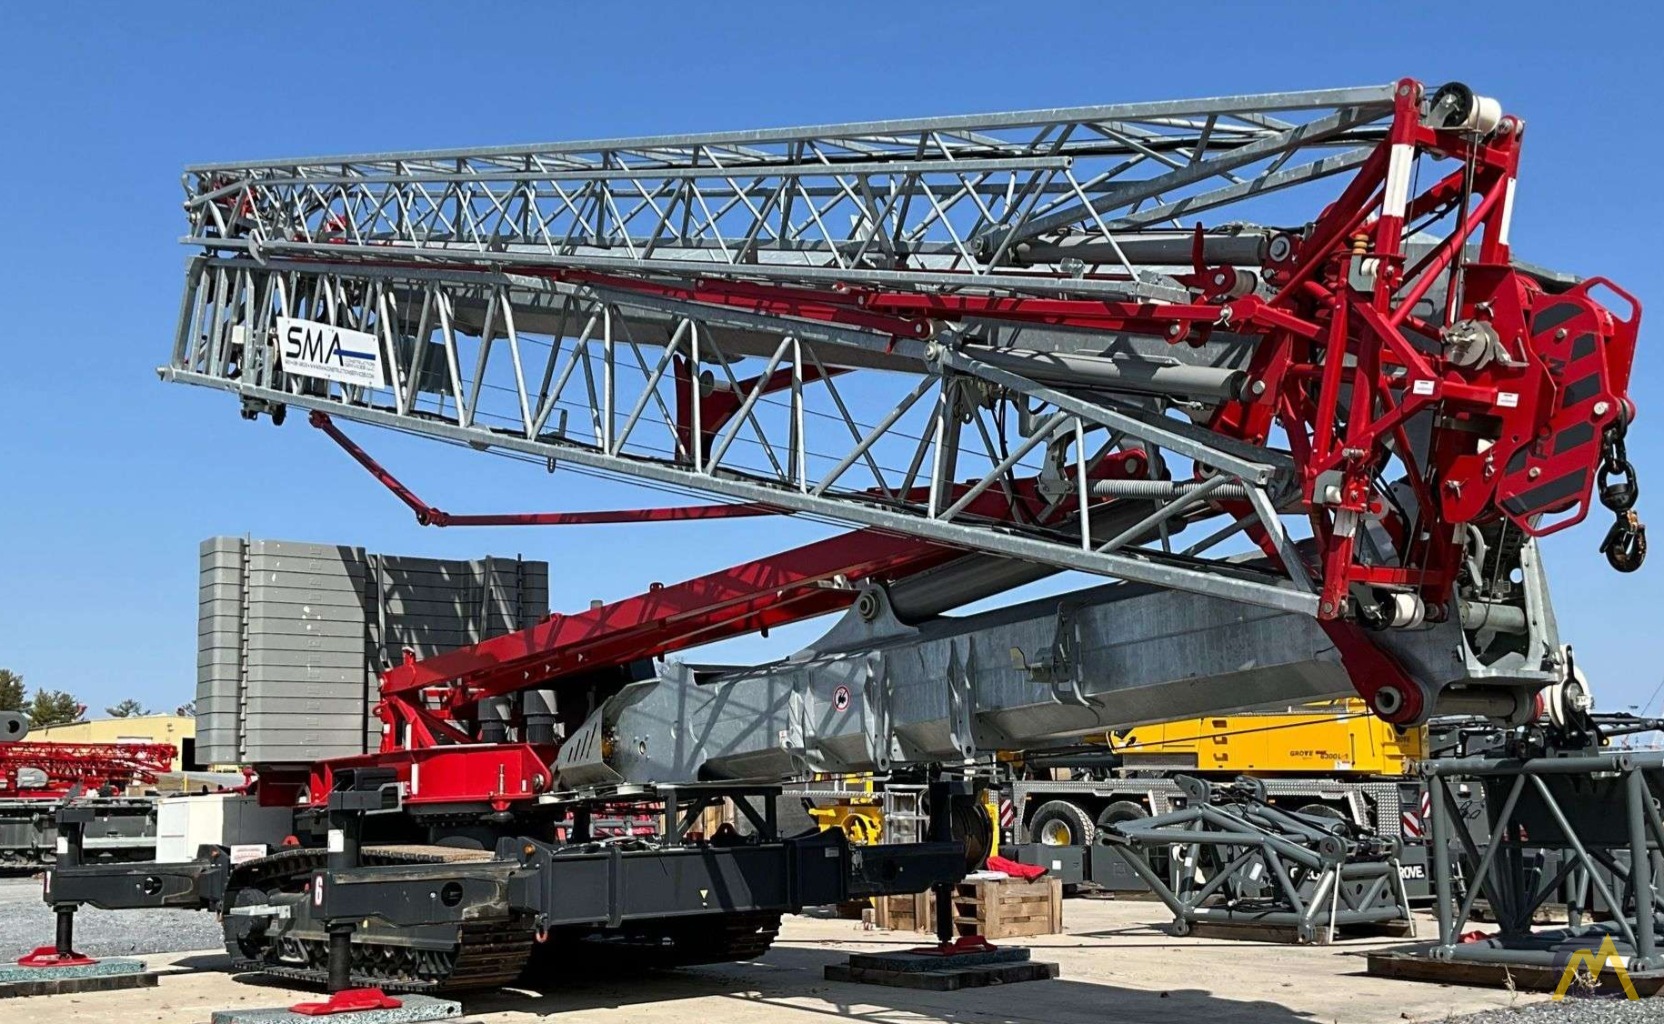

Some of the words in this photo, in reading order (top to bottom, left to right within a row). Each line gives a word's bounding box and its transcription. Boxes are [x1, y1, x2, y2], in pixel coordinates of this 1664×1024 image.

[286, 326, 344, 367] SMA
[1399, 865, 1425, 879] ROVE.
[315, 875, 324, 906] 6
